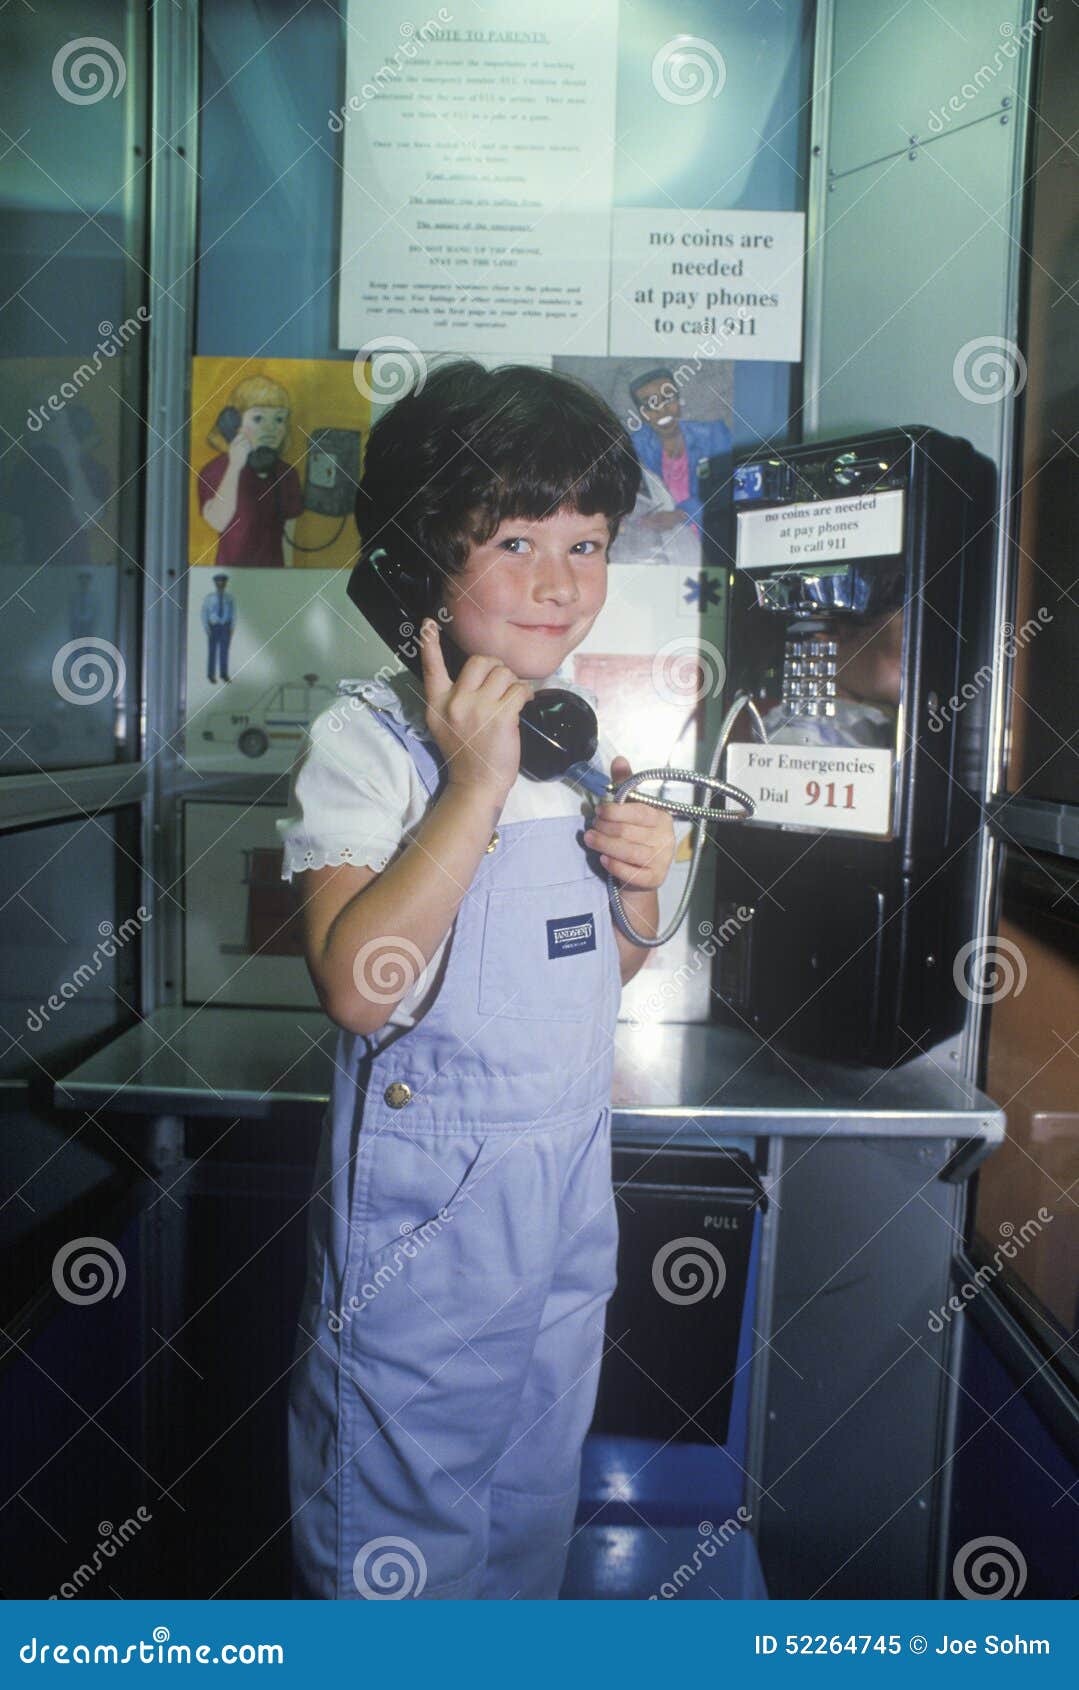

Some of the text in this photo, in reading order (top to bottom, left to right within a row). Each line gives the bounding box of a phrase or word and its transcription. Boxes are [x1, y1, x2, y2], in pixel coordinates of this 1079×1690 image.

[466, 30, 485, 42] TO
[649, 229, 774, 249] no coins are
[671, 259, 744, 277] needed
[634, 287, 779, 310] at pay phones
[654, 316, 757, 336] to call 911
[764, 498, 877, 523] no coins are needed
[779, 520, 859, 540] at pay phones
[789, 538, 847, 554] to call 911
[748, 753, 875, 774] For Emergencies
[759, 780, 857, 810] Dial 911
[703, 1215, 739, 1229] PULL
